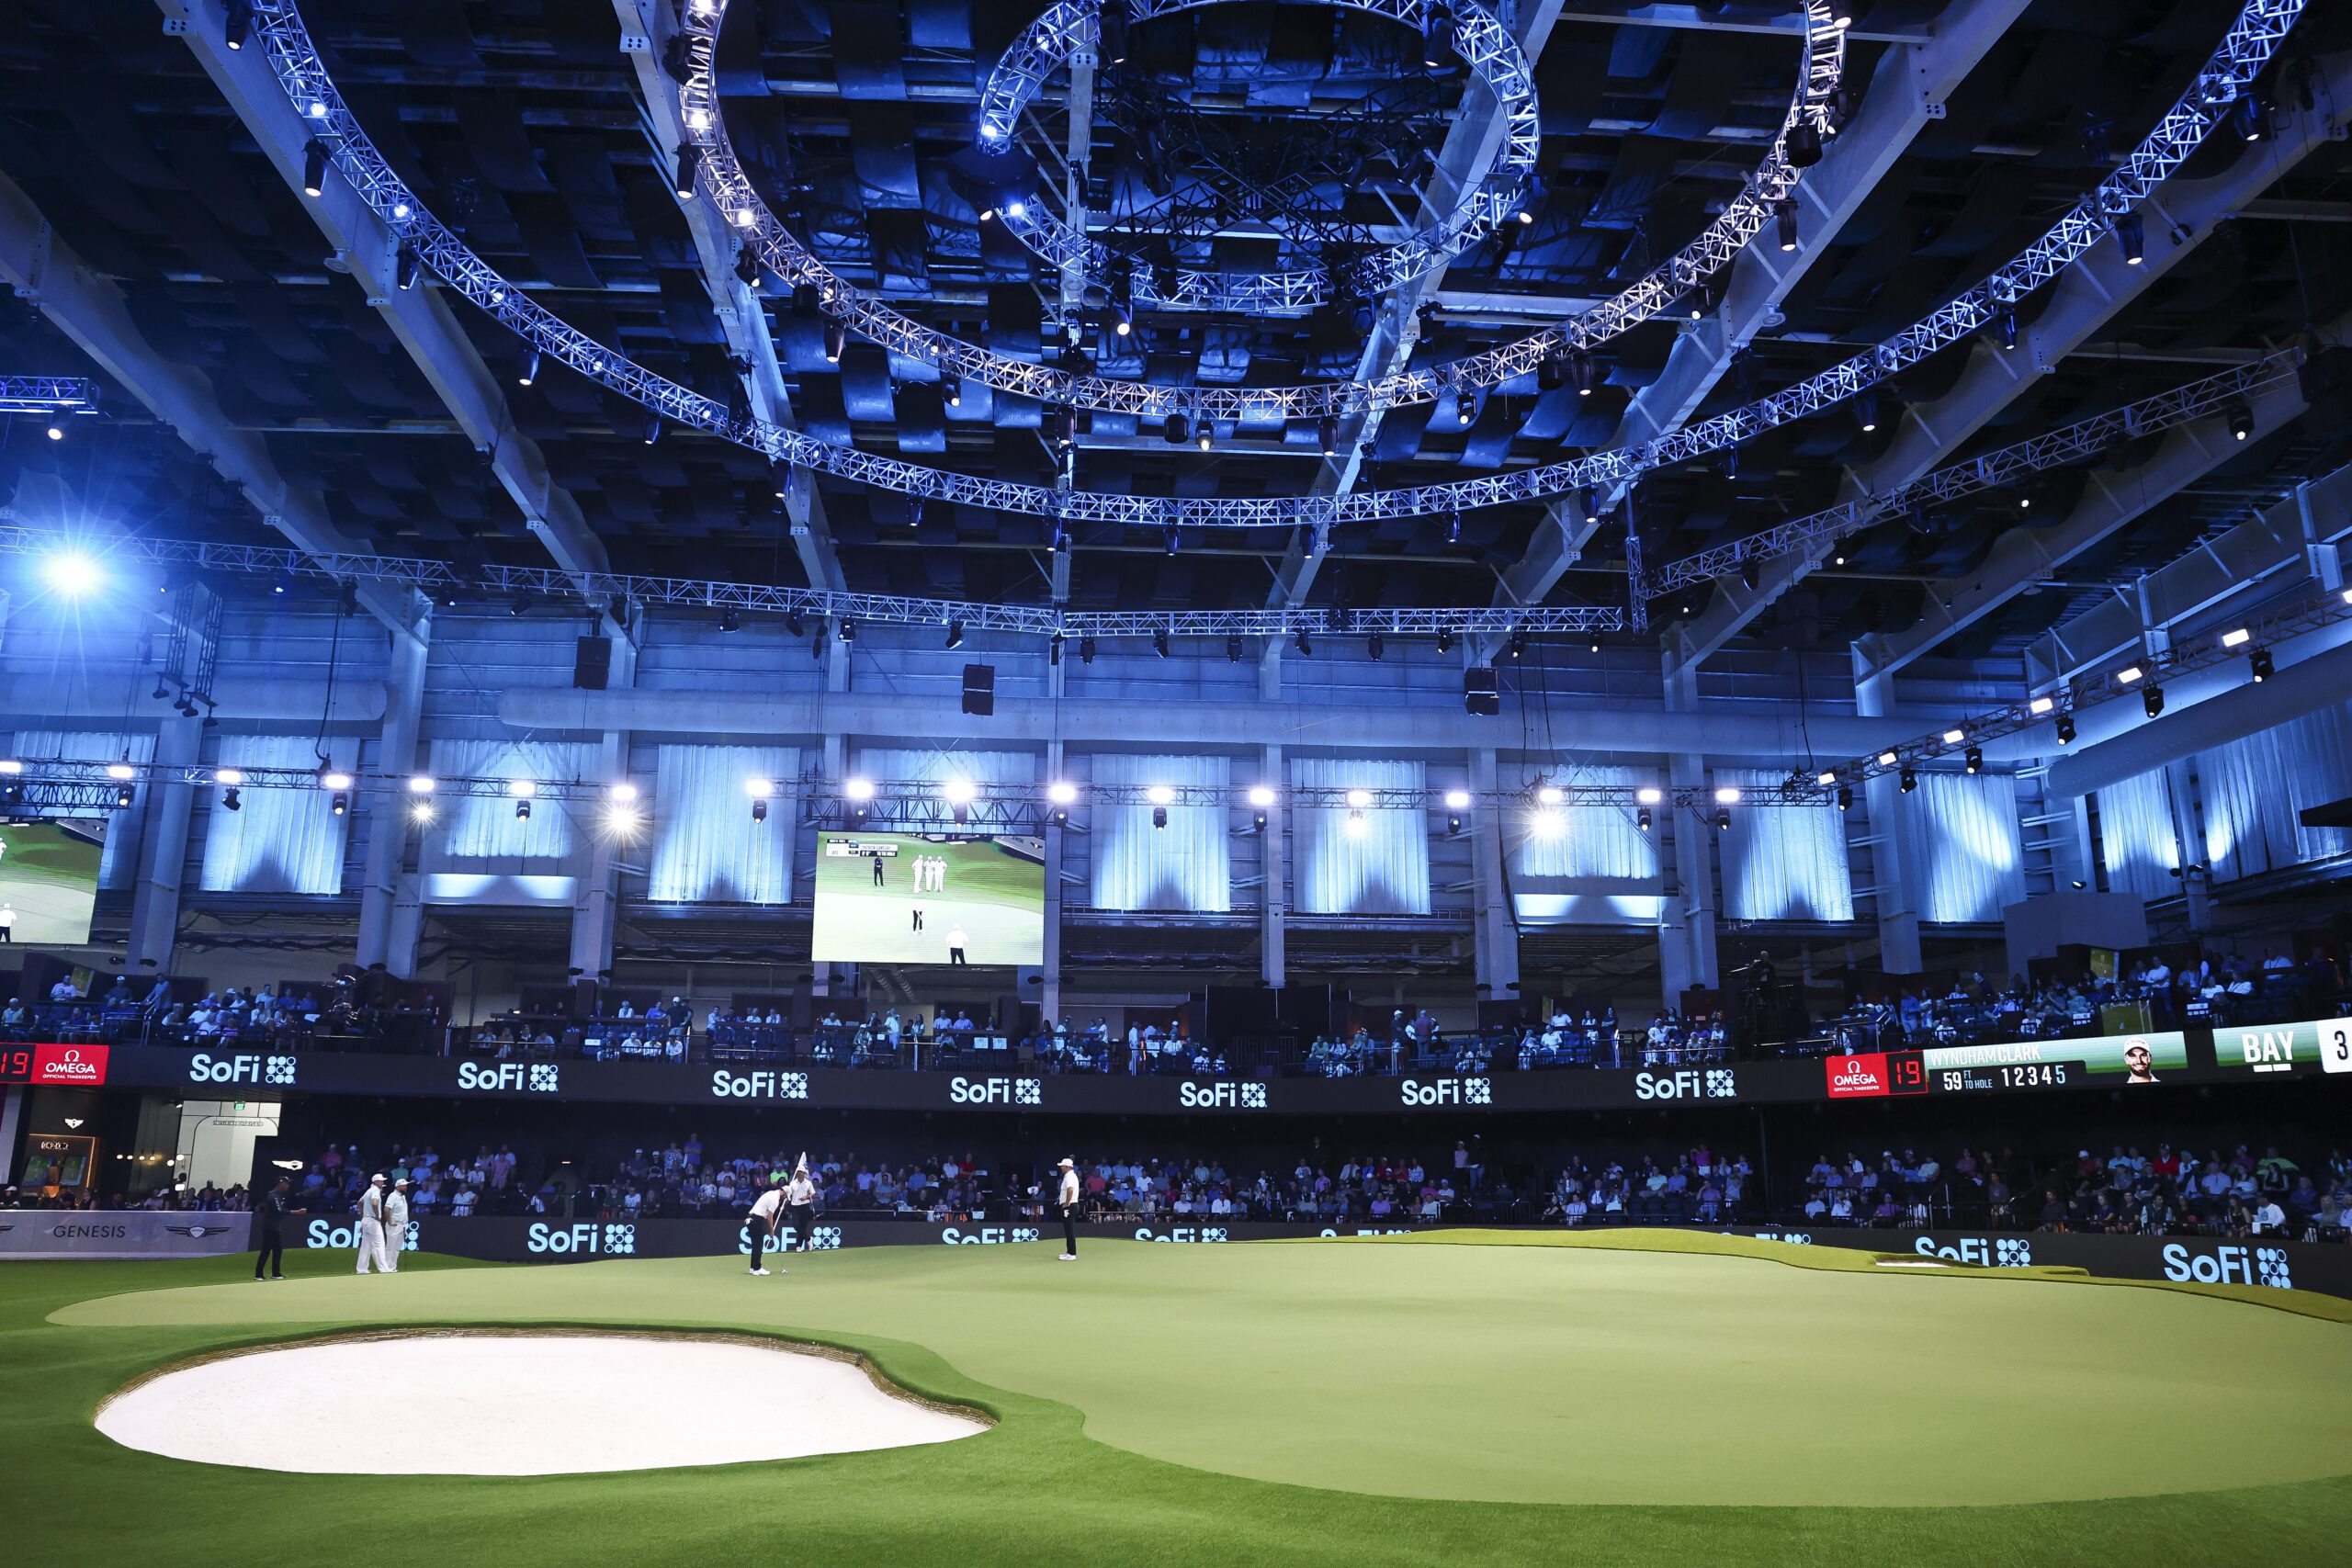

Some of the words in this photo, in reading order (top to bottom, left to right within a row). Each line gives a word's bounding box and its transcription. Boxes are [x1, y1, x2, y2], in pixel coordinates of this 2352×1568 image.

[1930, 1048, 1997, 1066] WYNDHAM
[1997, 1044, 2041, 1063] CLARK
[2241, 1031, 2294, 1063] BAY
[45, 1062, 96, 1074] OMEGA
[189, 1054, 261, 1083] SoFi
[458, 1061, 525, 1090] SoFi
[1834, 1073, 1877, 1086] OMEGA
[1895, 1060, 1921, 1085] 19
[1942, 1071, 1962, 1091] 59
[1963, 1069, 1972, 1079] FT
[712, 1069, 775, 1098] SoFi
[950, 1077, 1010, 1103] SoFi
[1180, 1081, 1236, 1108] SoFi
[1401, 1078, 1459, 1106] SoFi
[1635, 1070, 1701, 1100] SoFi
[1964, 1079, 1974, 1089] TO
[1975, 1078, 1993, 1089] HOLE
[52, 1224, 127, 1238] GENESIS
[527, 1223, 598, 1253] SoFi
[2163, 1243, 2253, 1285] SoFi
